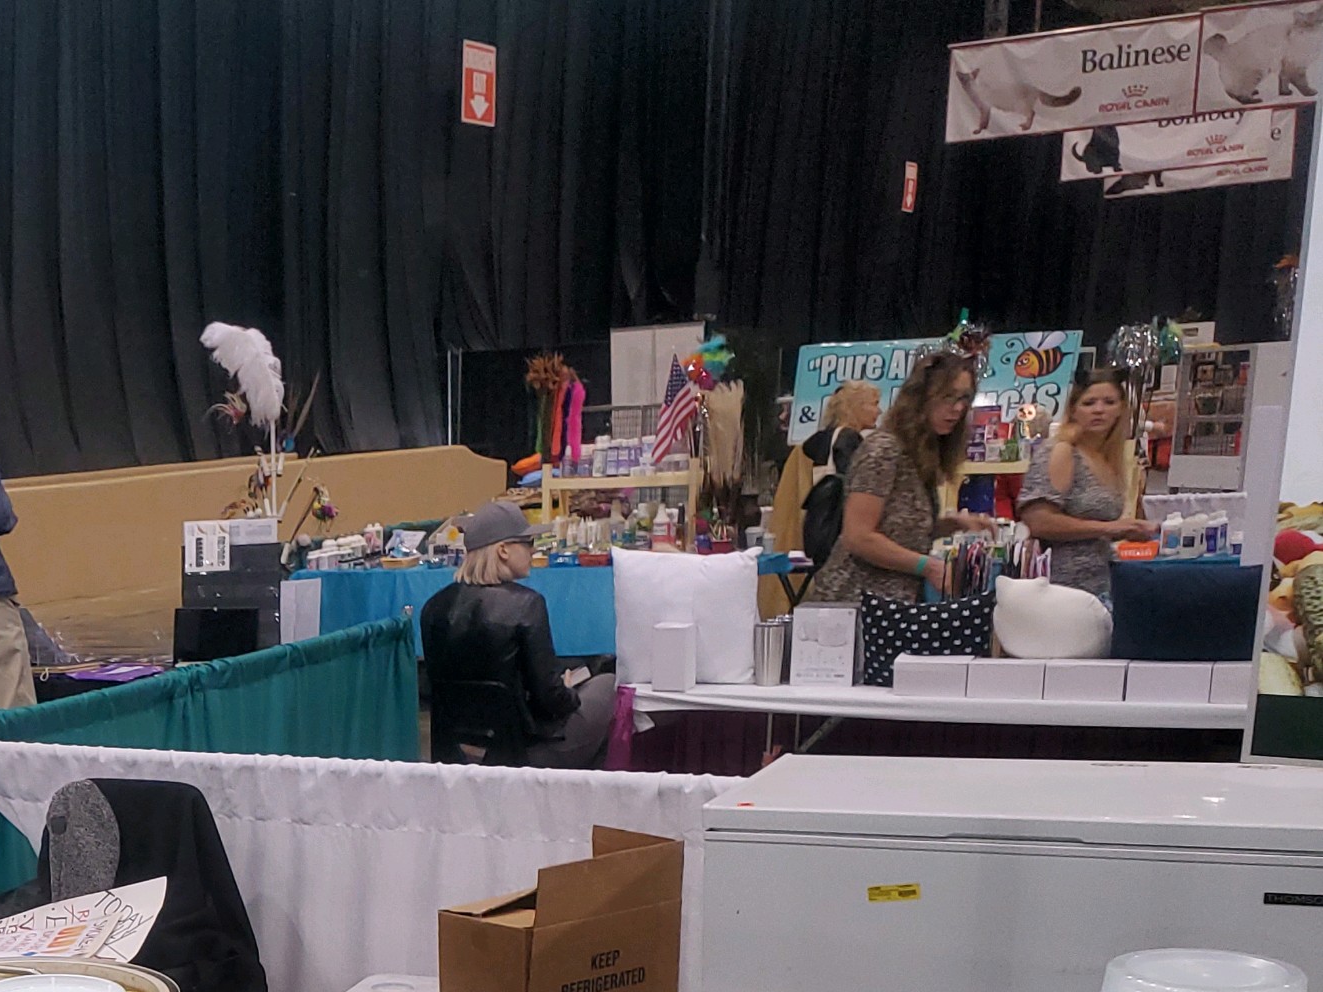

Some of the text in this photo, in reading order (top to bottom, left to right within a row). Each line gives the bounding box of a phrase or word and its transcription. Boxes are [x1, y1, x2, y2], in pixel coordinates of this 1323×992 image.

[1080, 42, 1191, 74] Balinese
[798, 405, 817, 424] &
[590, 950, 621, 971] KEEP
